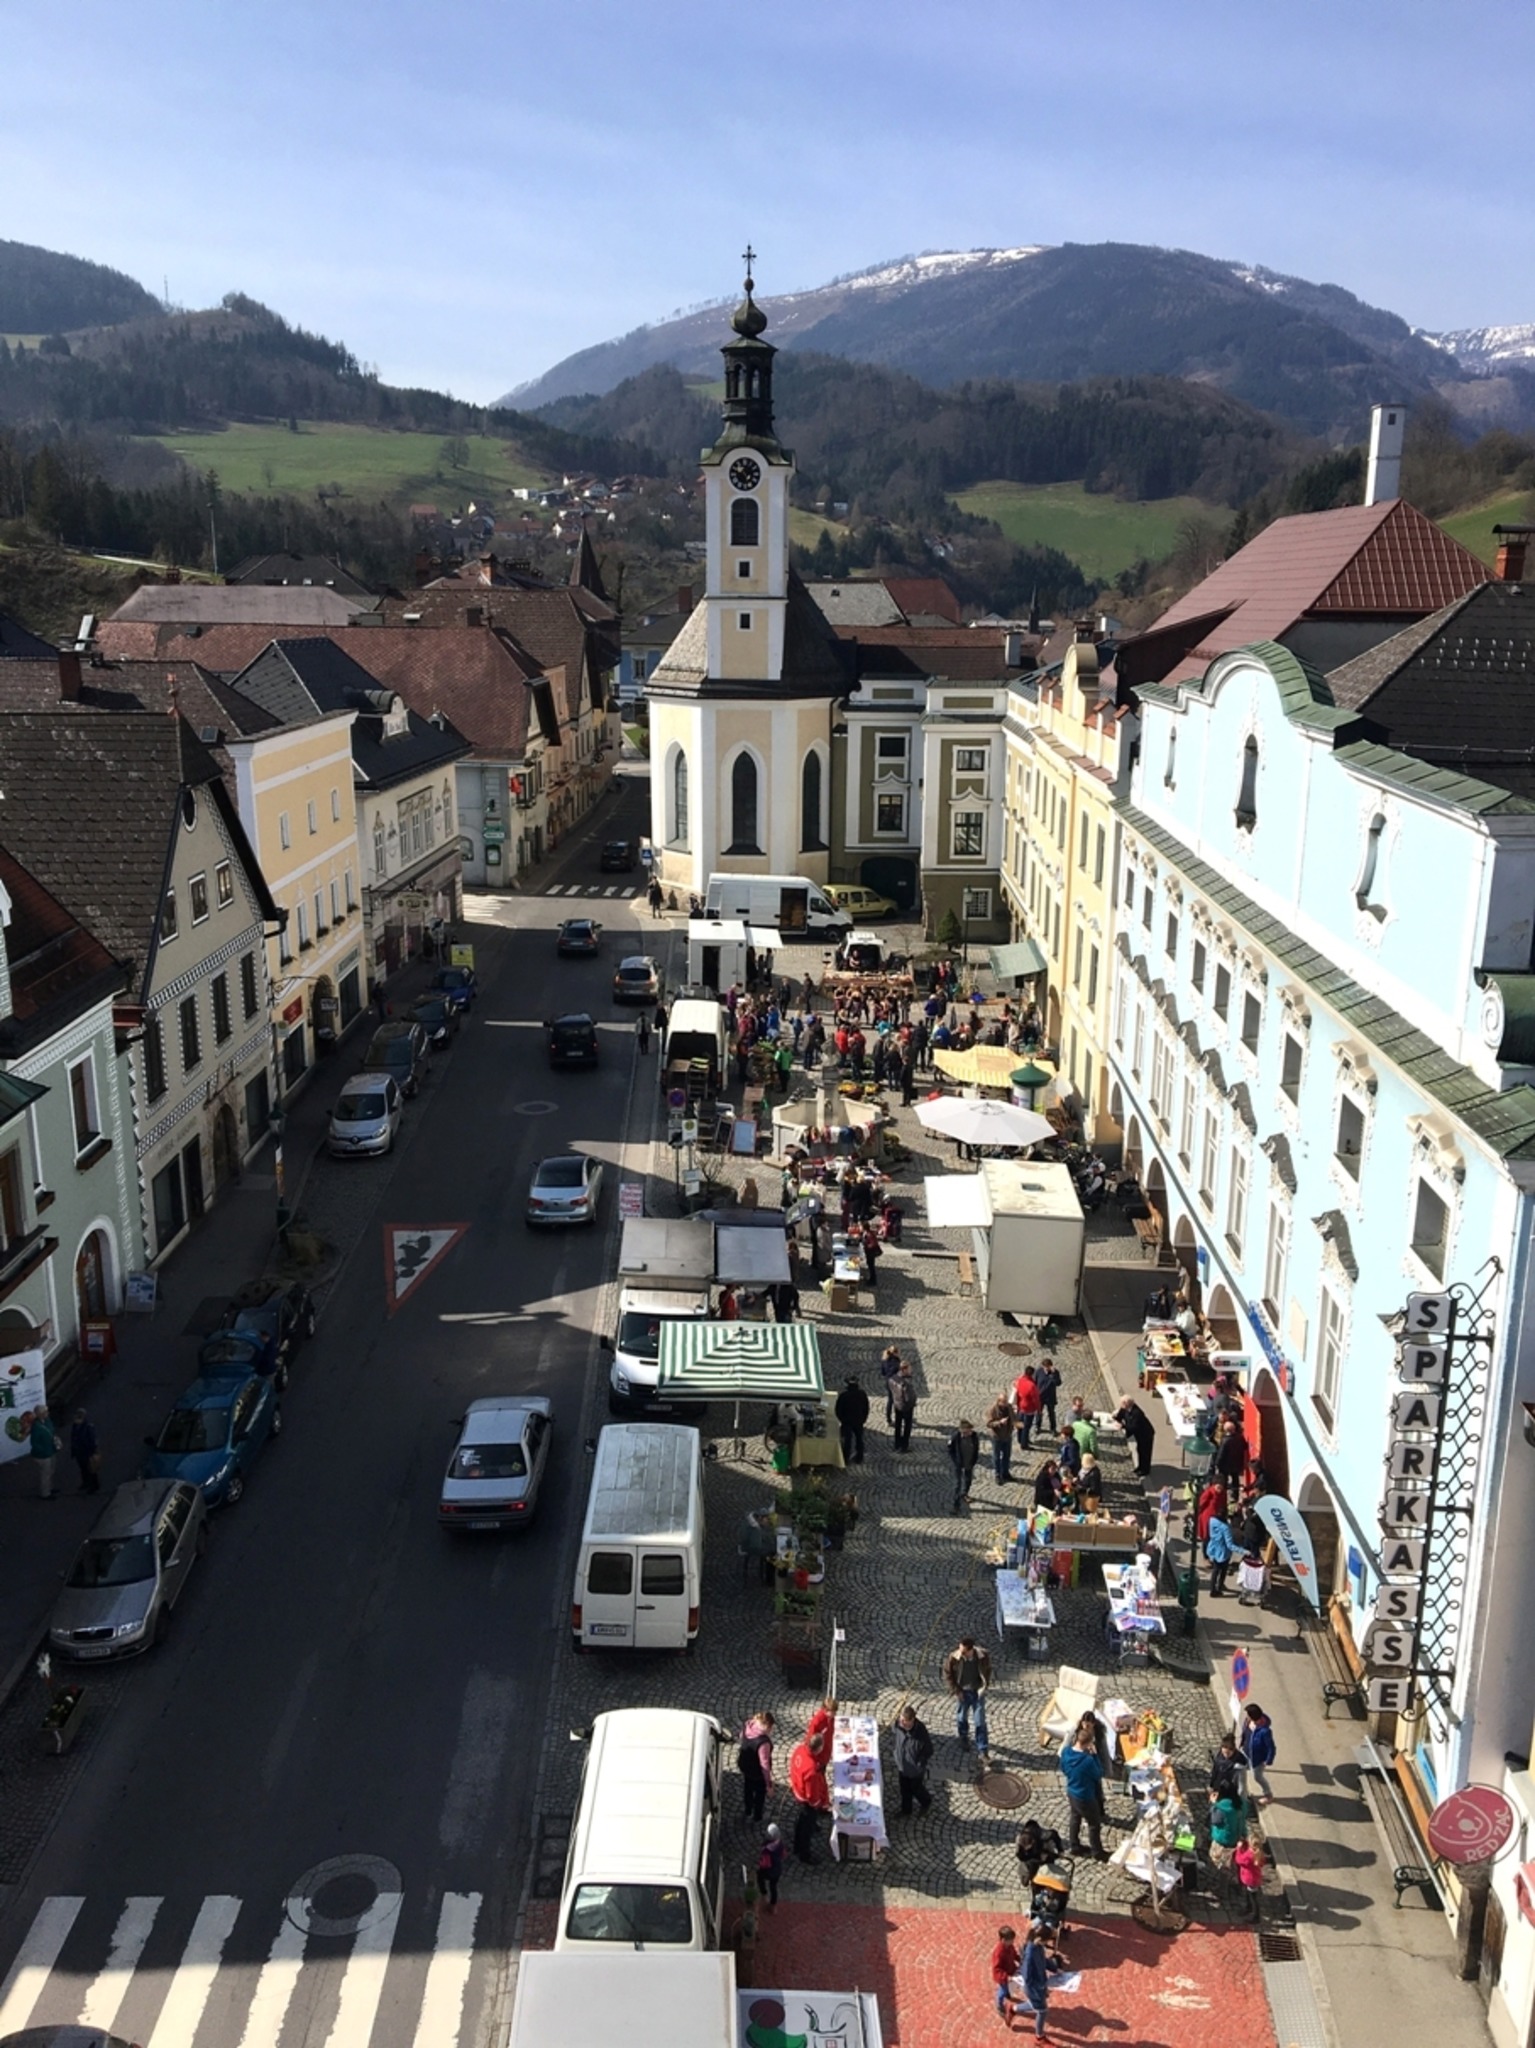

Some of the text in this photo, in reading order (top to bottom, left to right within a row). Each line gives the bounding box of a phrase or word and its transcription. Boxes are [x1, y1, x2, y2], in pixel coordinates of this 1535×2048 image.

[1379, 1300, 1441, 1708] SPARKASSE
[1463, 1805, 1511, 1863] RED ZAC
